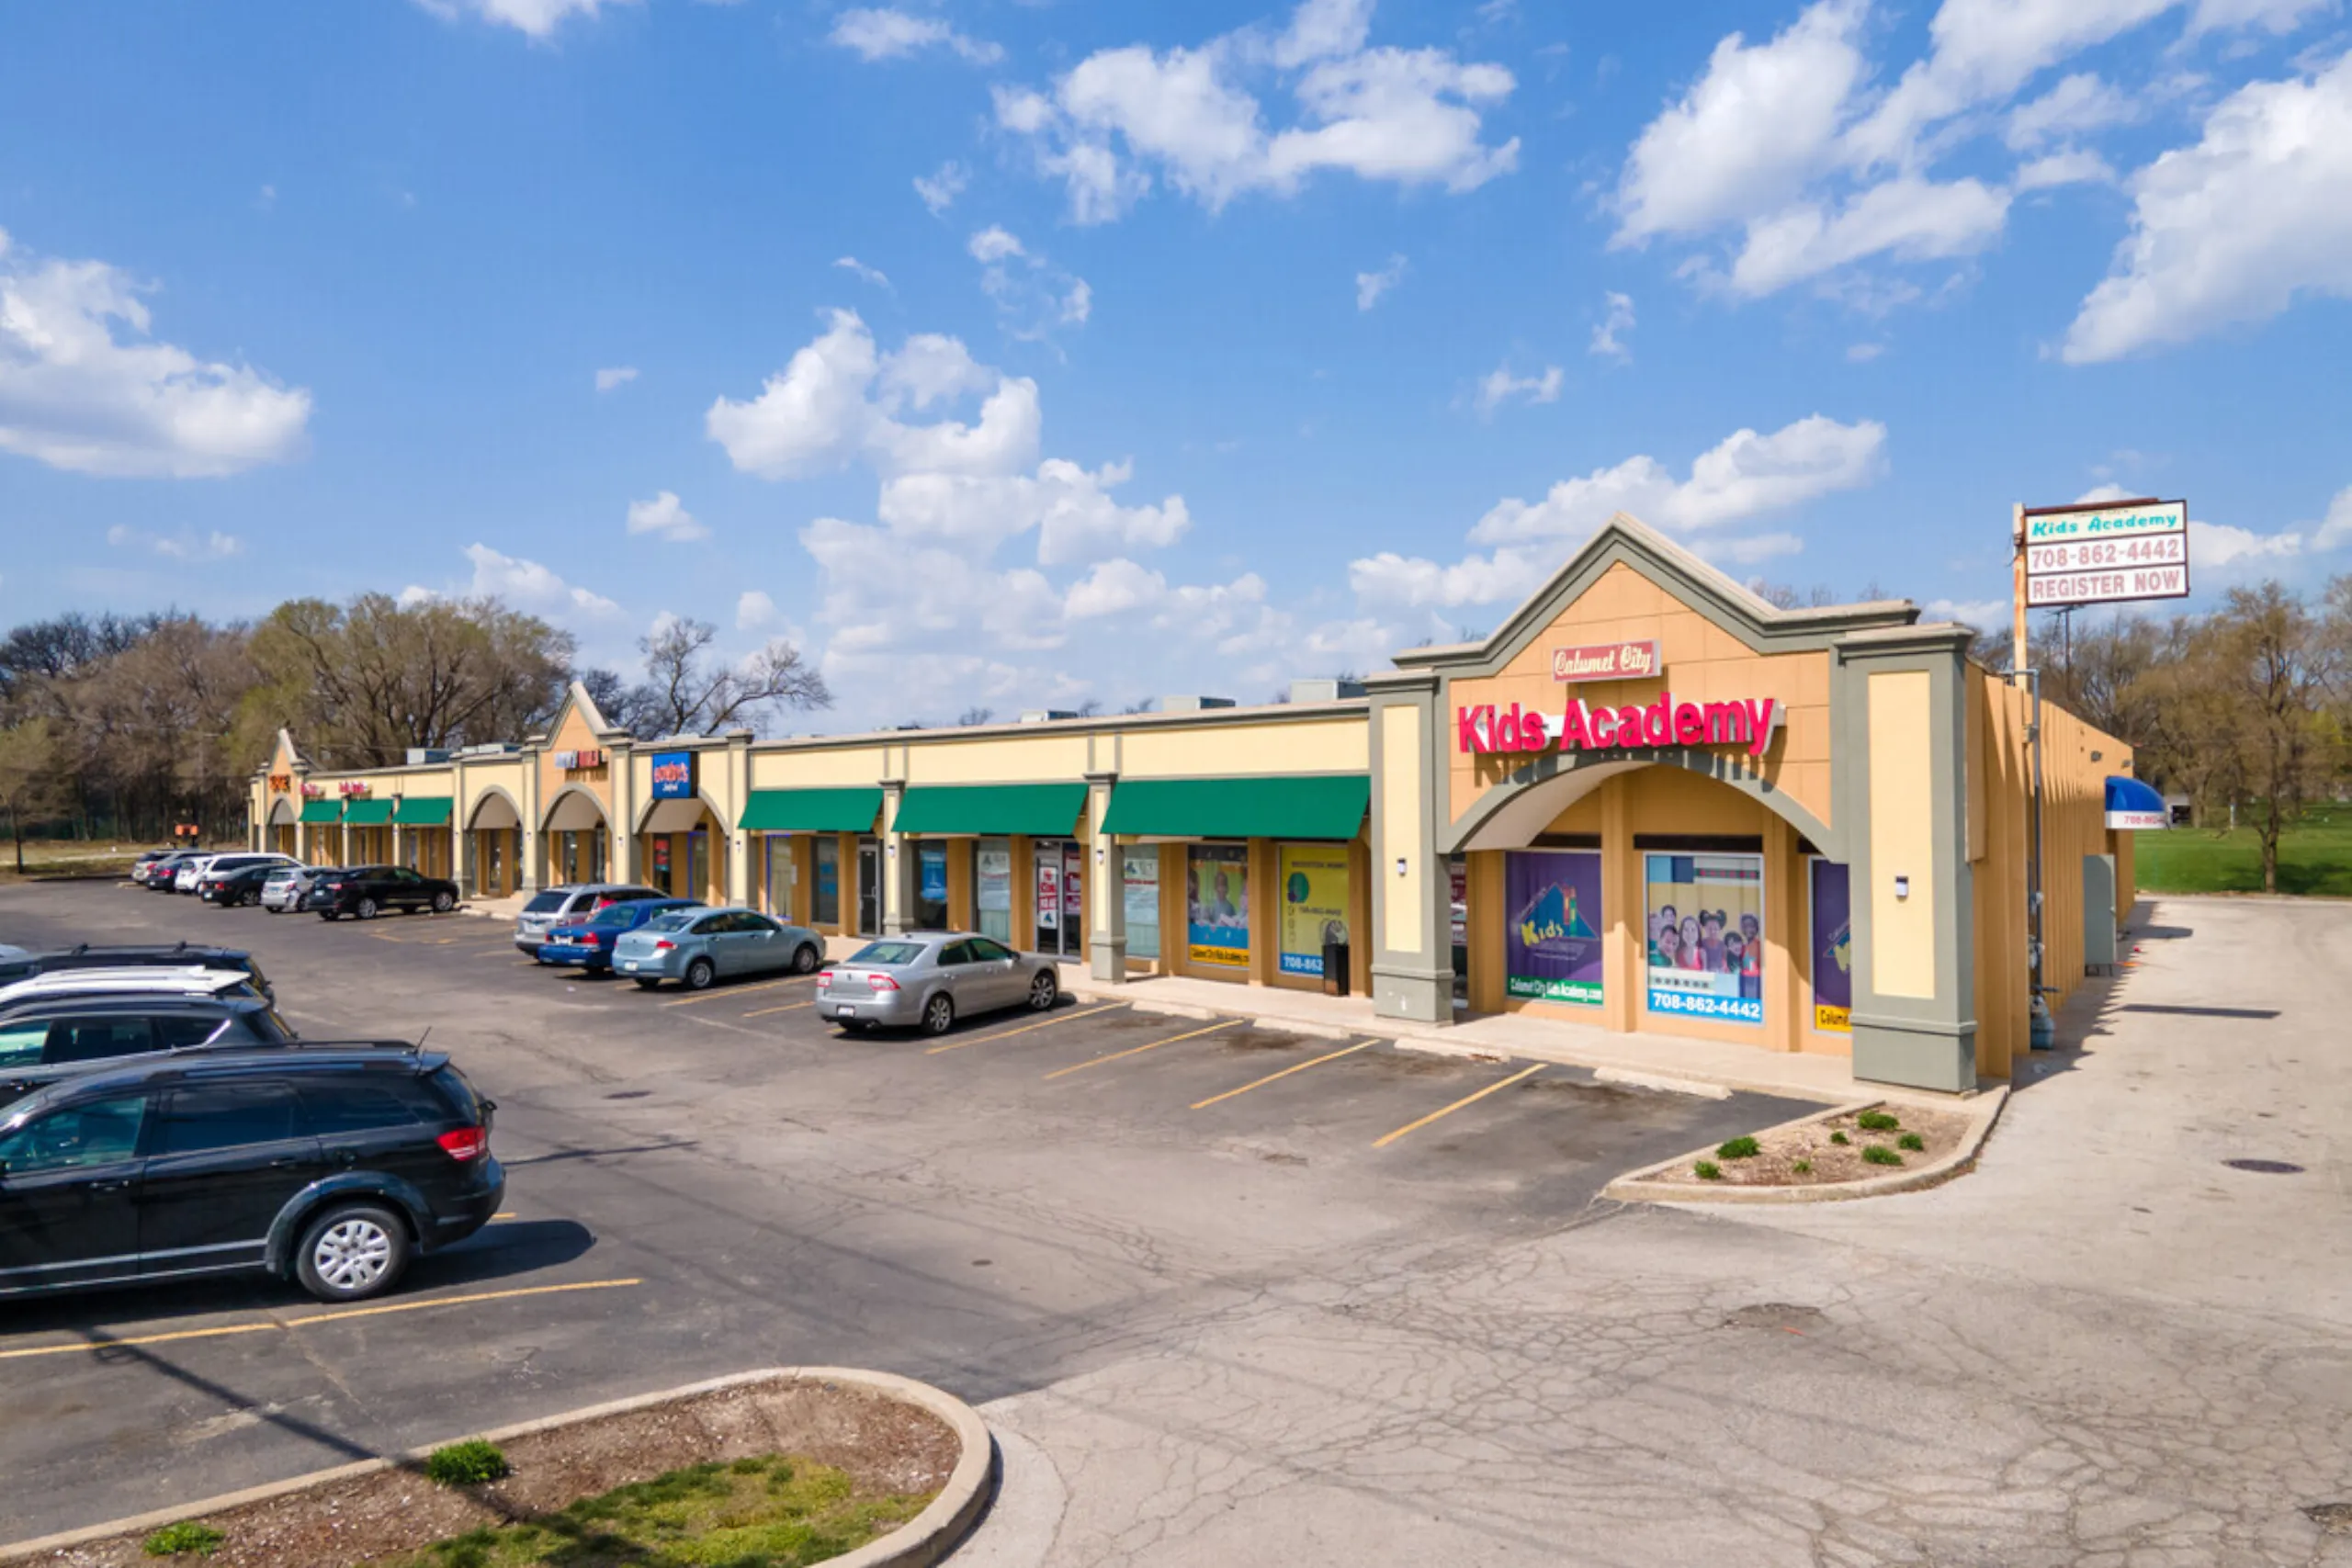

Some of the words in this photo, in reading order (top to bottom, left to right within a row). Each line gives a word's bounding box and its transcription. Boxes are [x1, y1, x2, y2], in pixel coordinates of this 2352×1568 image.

[2032, 520, 2078, 537] Kids
[2088, 514, 2177, 533] Academy
[2031, 538, 2180, 569] 708-862-4442
[2033, 575, 2125, 599] REGISTER
[2134, 570, 2180, 592] NOW
[1555, 649, 1615, 676] Calumet
[1620, 645, 1651, 675] City
[1458, 702, 1549, 754] Kids
[1560, 693, 1778, 756] Academy
[1521, 919, 1564, 948] Kids
[1652, 992, 1760, 1018] 708-862-4442
